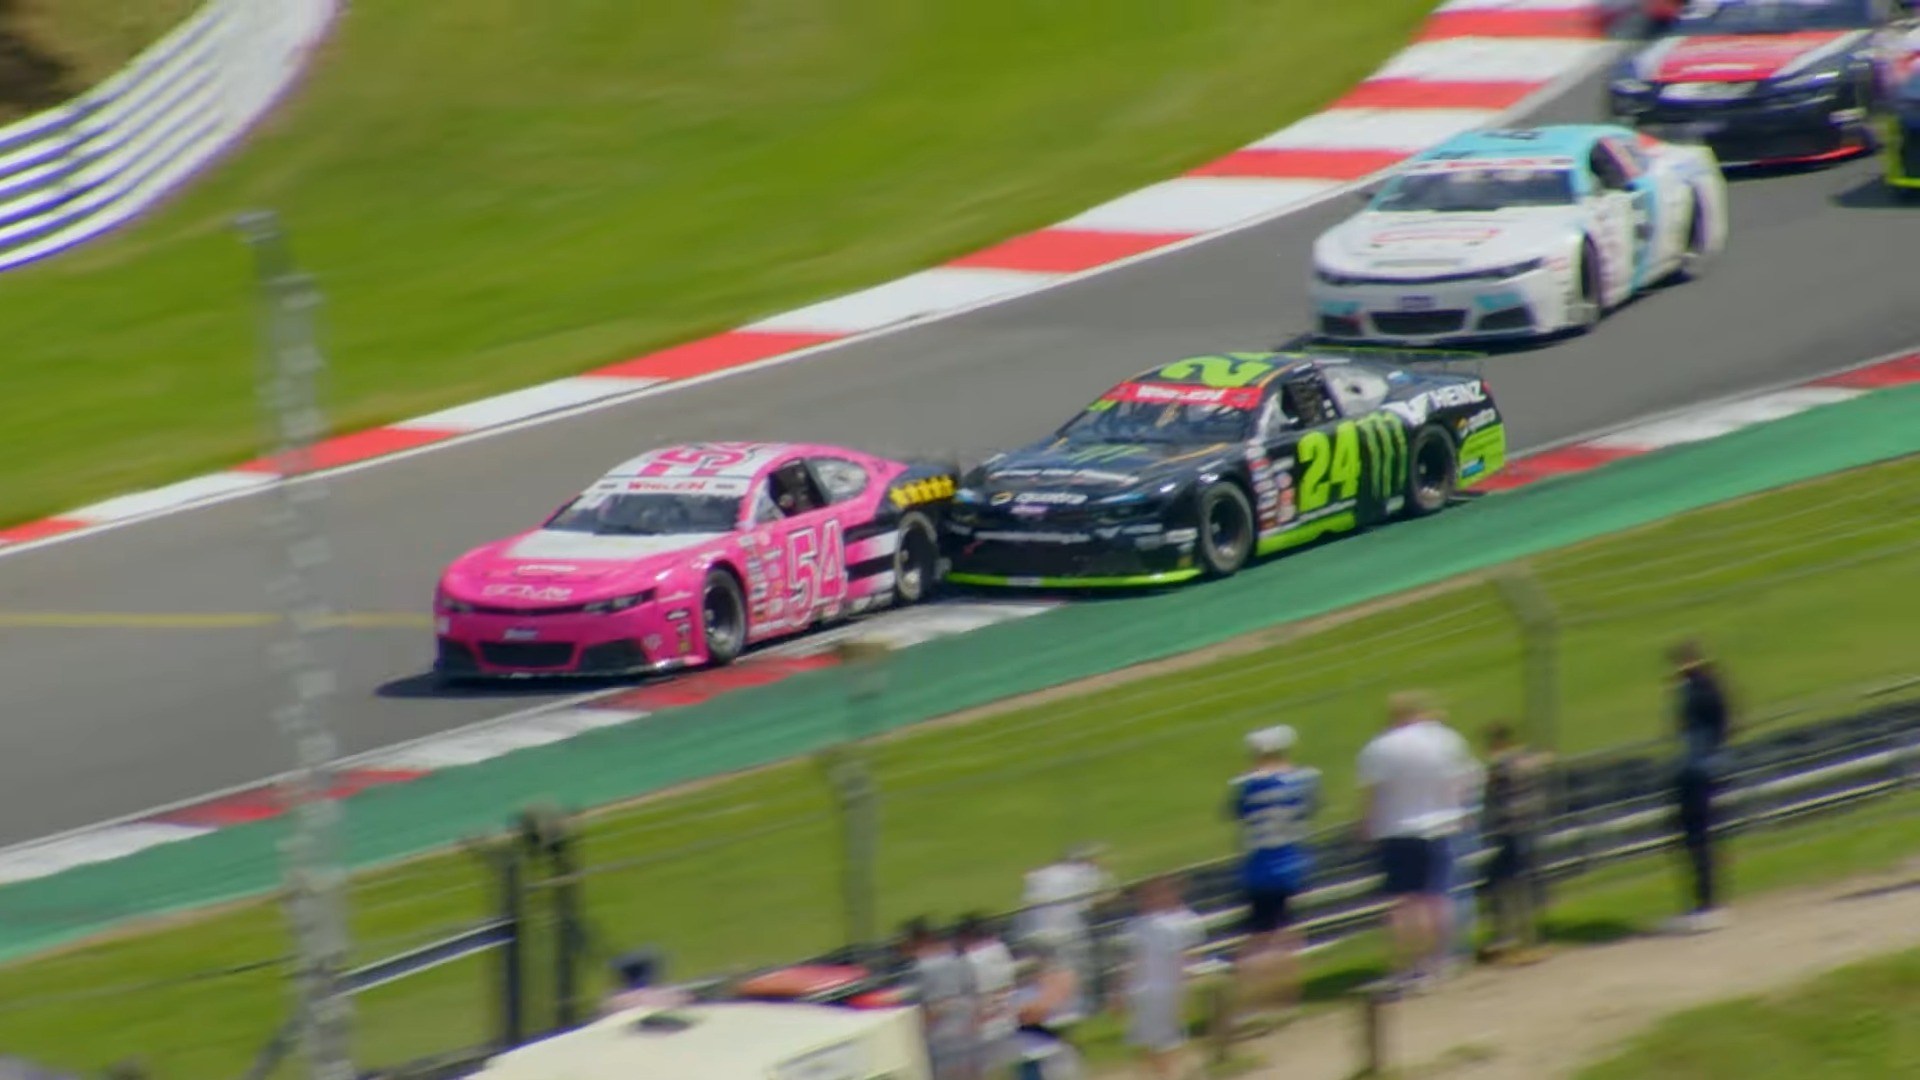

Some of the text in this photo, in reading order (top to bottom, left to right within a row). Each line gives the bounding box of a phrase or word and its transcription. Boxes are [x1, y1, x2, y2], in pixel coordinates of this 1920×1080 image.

[1428, 380, 1487, 409] HEINZ
[1298, 421, 1361, 513] 24
[788, 519, 848, 626] 54
